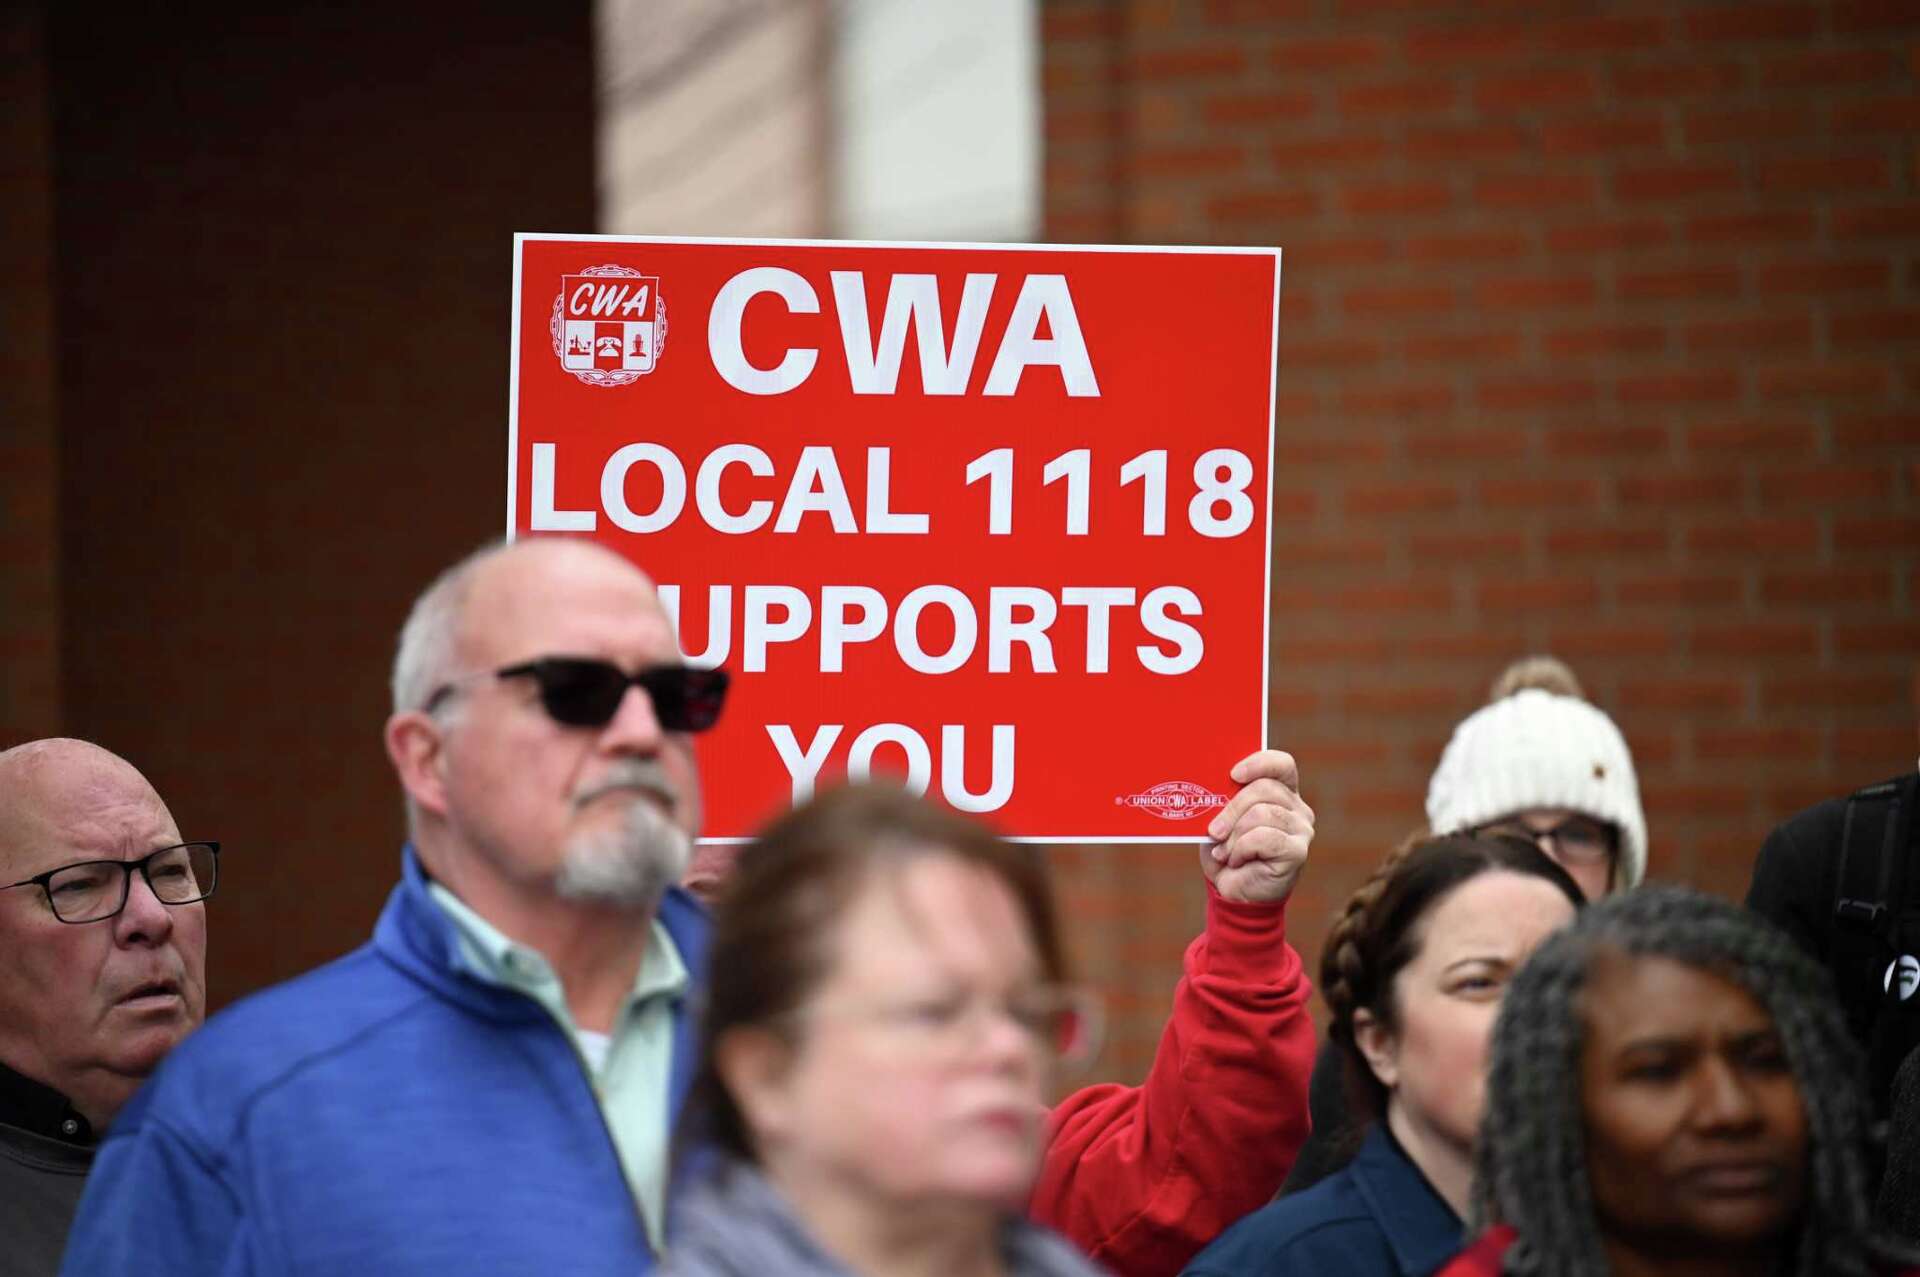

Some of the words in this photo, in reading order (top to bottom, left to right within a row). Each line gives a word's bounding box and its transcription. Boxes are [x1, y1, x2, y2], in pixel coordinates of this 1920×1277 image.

[570, 282, 649, 317] CWA
[706, 266, 1101, 397] CWA
[530, 443, 930, 535] LOCAL
[965, 448, 1255, 538] 1118
[657, 584, 1205, 675] UPPORTS
[765, 723, 1015, 813] YOU
[1132, 796, 1166, 805] UNION
[1168, 794, 1186, 808] CWA
[1191, 796, 1224, 805] LABEL
